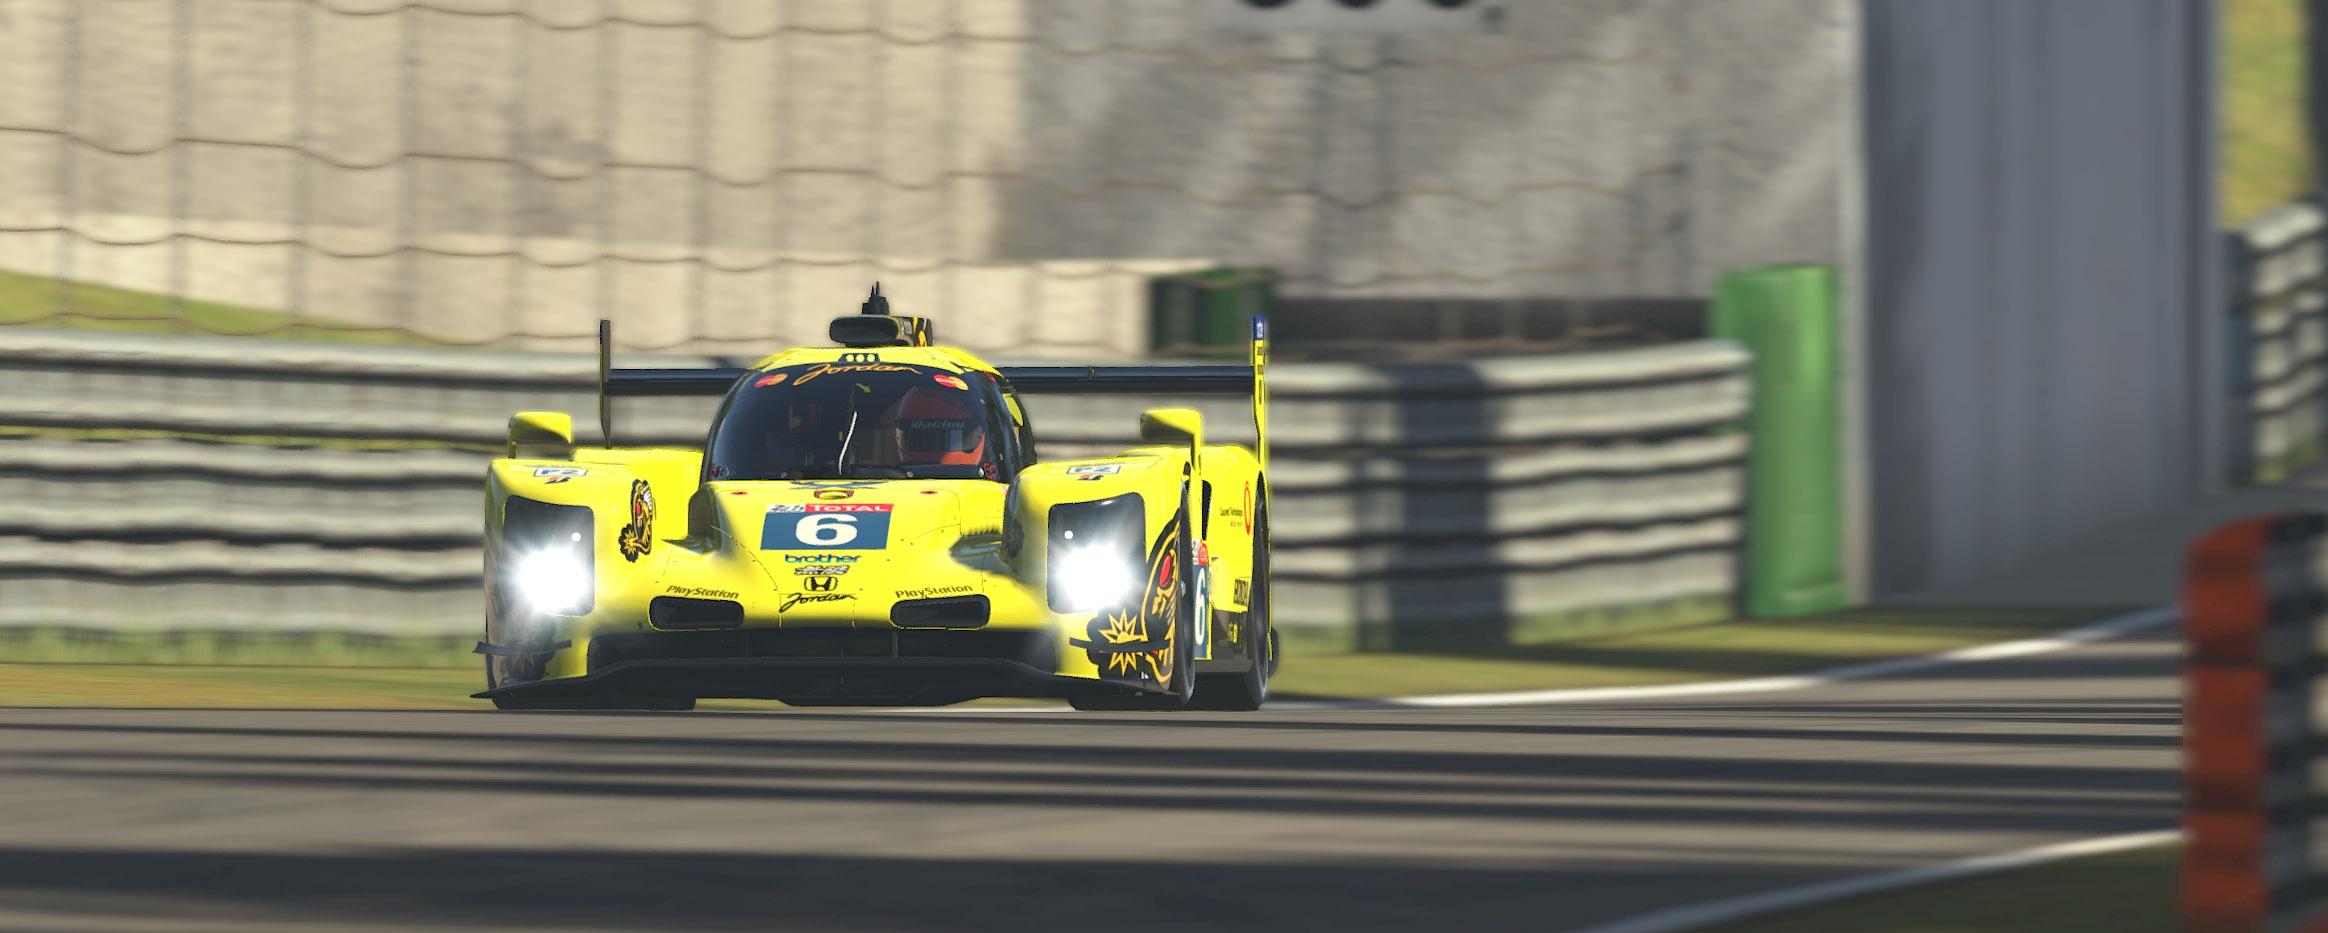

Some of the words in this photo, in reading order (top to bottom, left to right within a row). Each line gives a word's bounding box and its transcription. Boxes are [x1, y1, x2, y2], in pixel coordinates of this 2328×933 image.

[793, 363, 922, 386] Jordan
[795, 513, 858, 546] 6
[784, 553, 862, 563] brother
[666, 584, 740, 600] PlayStation
[779, 592, 858, 613] Jordan
[895, 585, 973, 599] PlayStation
[1194, 567, 1206, 646] 6
